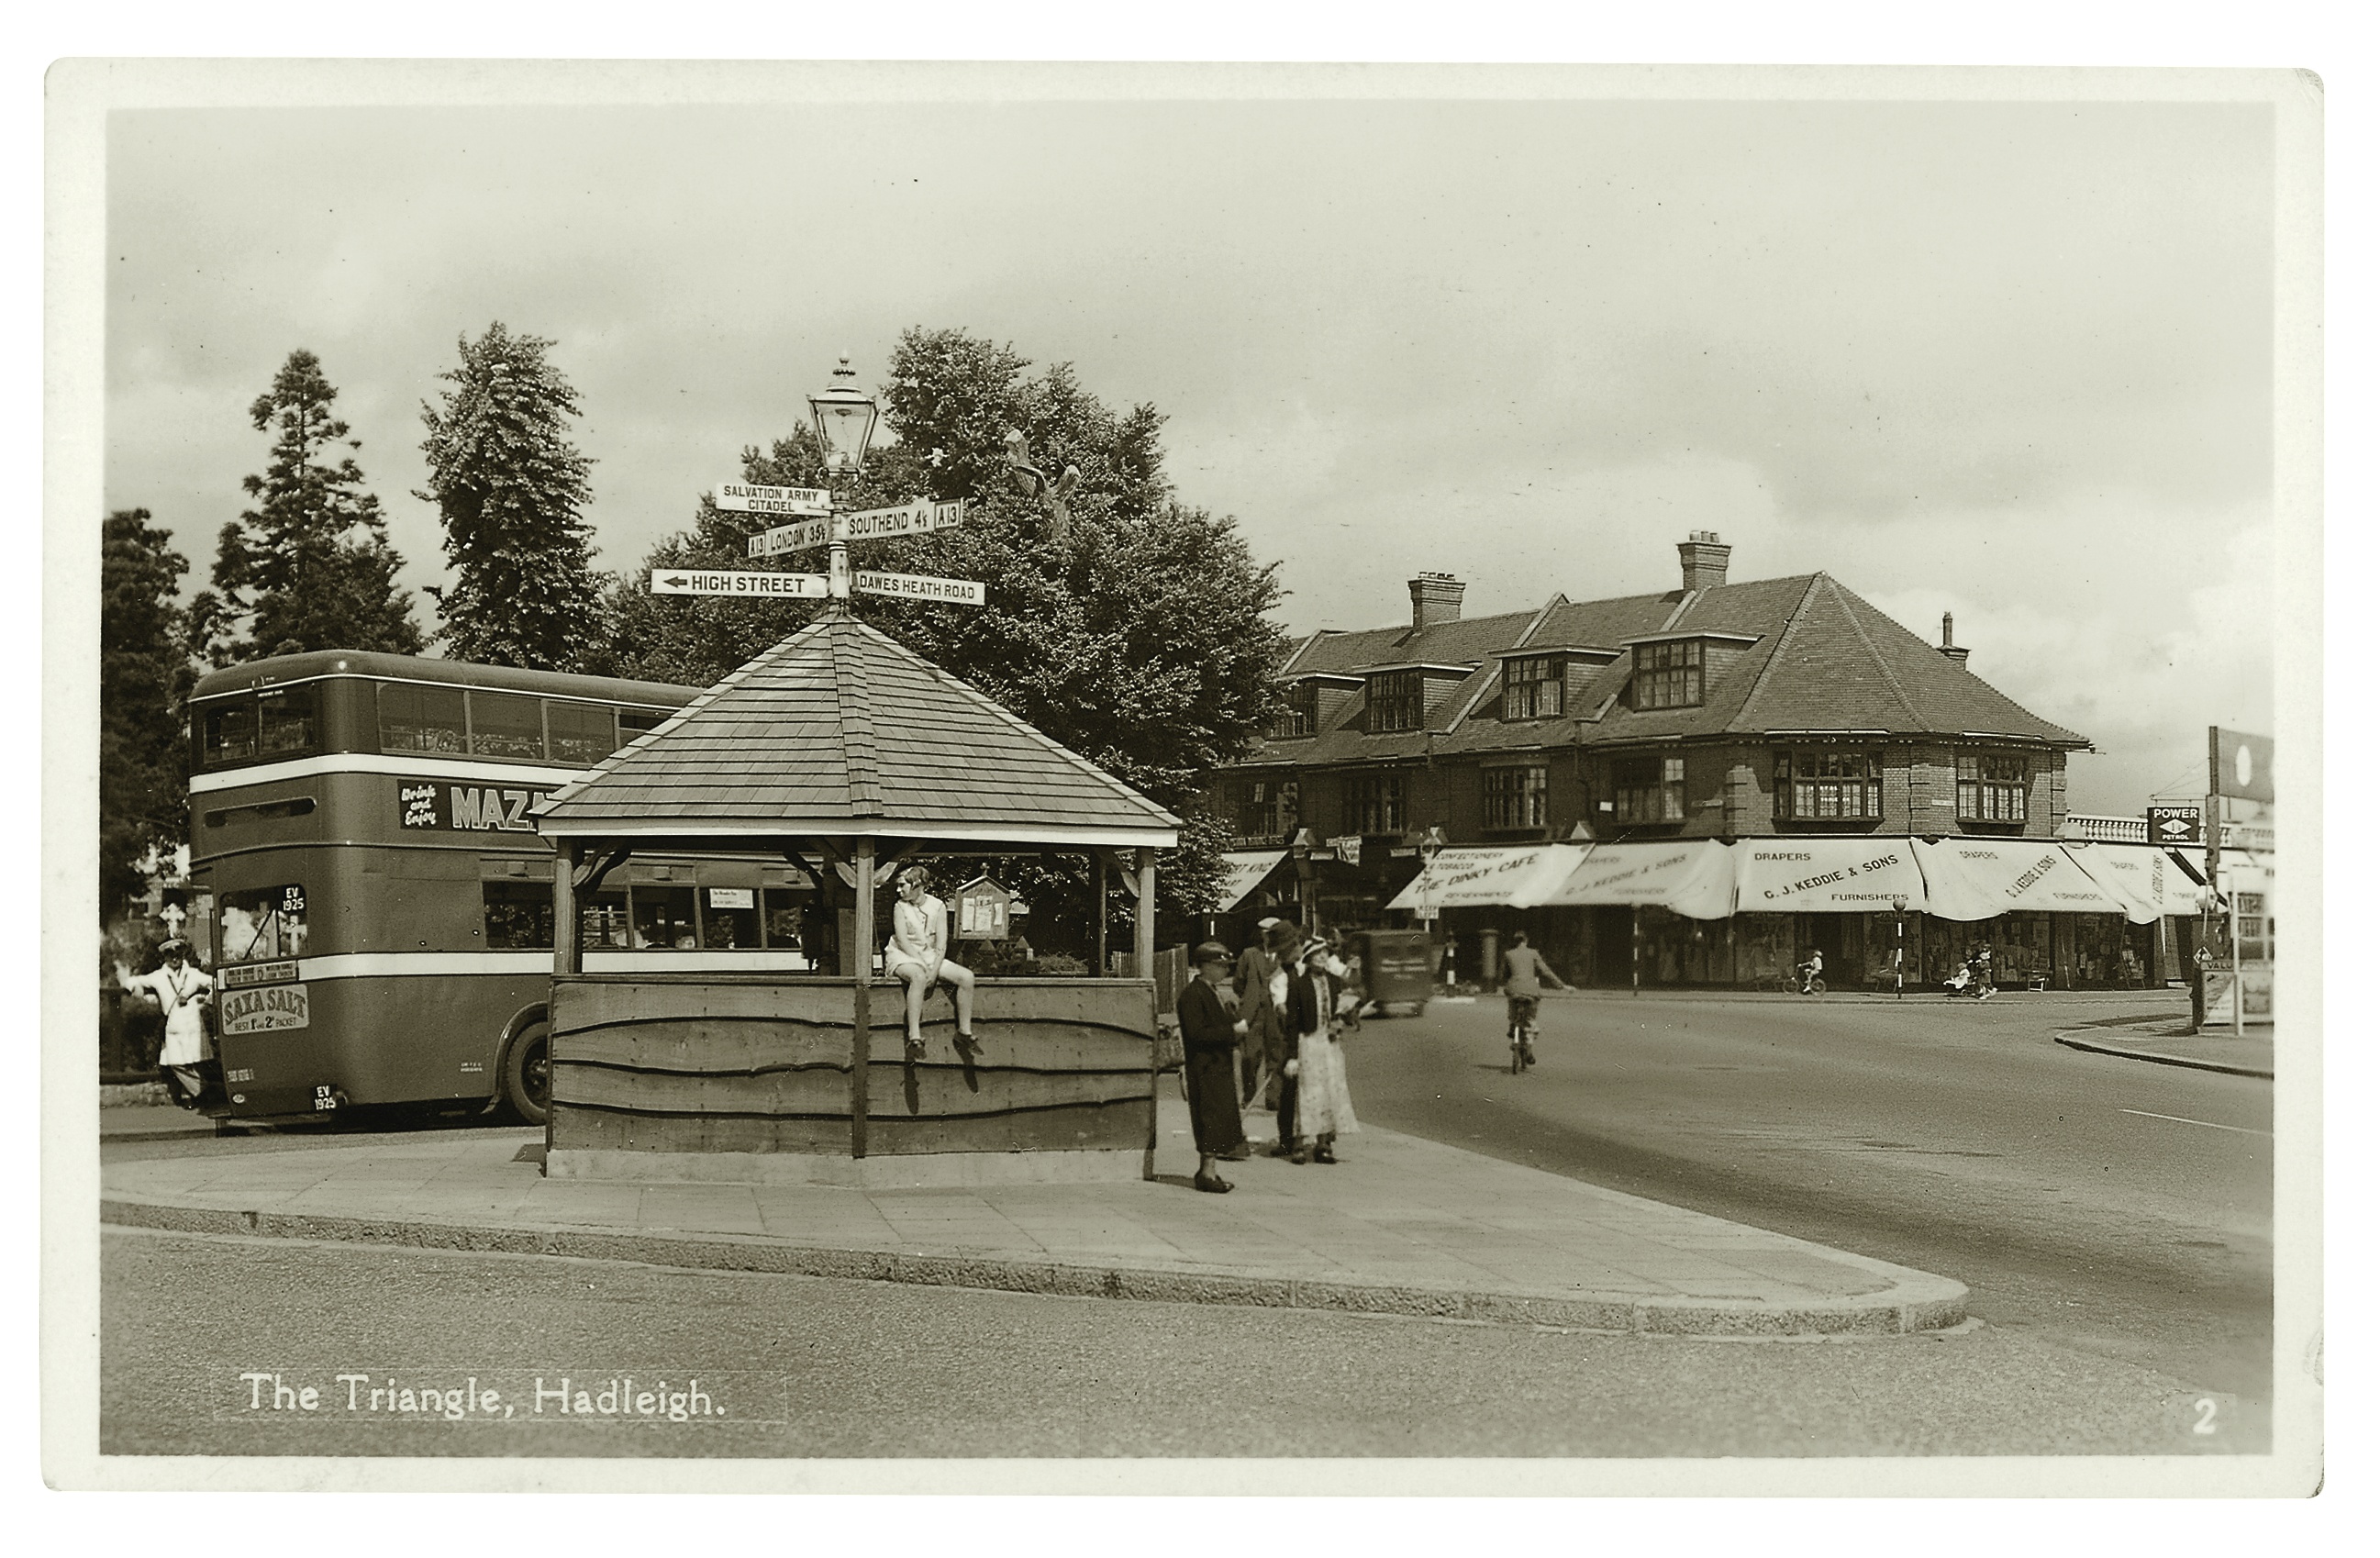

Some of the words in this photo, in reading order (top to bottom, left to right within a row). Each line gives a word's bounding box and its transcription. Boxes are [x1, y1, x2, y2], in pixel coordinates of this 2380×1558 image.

[724, 485, 782, 499] SALVATION
[787, 490, 818, 502] ARMY
[748, 499, 795, 513] CITADEL
[849, 512, 908, 535] SOUTHEND
[771, 528, 806, 551] LONDON
[692, 575, 731, 591] HIGH
[736, 577, 805, 593] STREET
[859, 574, 899, 592] DAWES
[903, 580, 941, 595] HEATH
[944, 584, 974, 599] ROAD
[401, 785, 437, 801] Drink
[410, 797, 432, 811] and
[405, 808, 437, 826] Enjoy
[2153, 808, 2198, 818] POWER
[1655, 854, 1687, 870] SONS
[2037, 854, 2057, 873] SONS
[1448, 868, 1492, 886] DINKY
[1794, 871, 1844, 891] KEDDIE
[1847, 867, 1859, 877] &
[1862, 854, 1899, 873] SONS
[286, 886, 298, 898] EV
[283, 897, 304, 911] 1925
[224, 991, 264, 1026] SAXA
[266, 989, 306, 1018] SALT
[317, 1085, 329, 1096] EV
[315, 1097, 336, 1110] 1925
